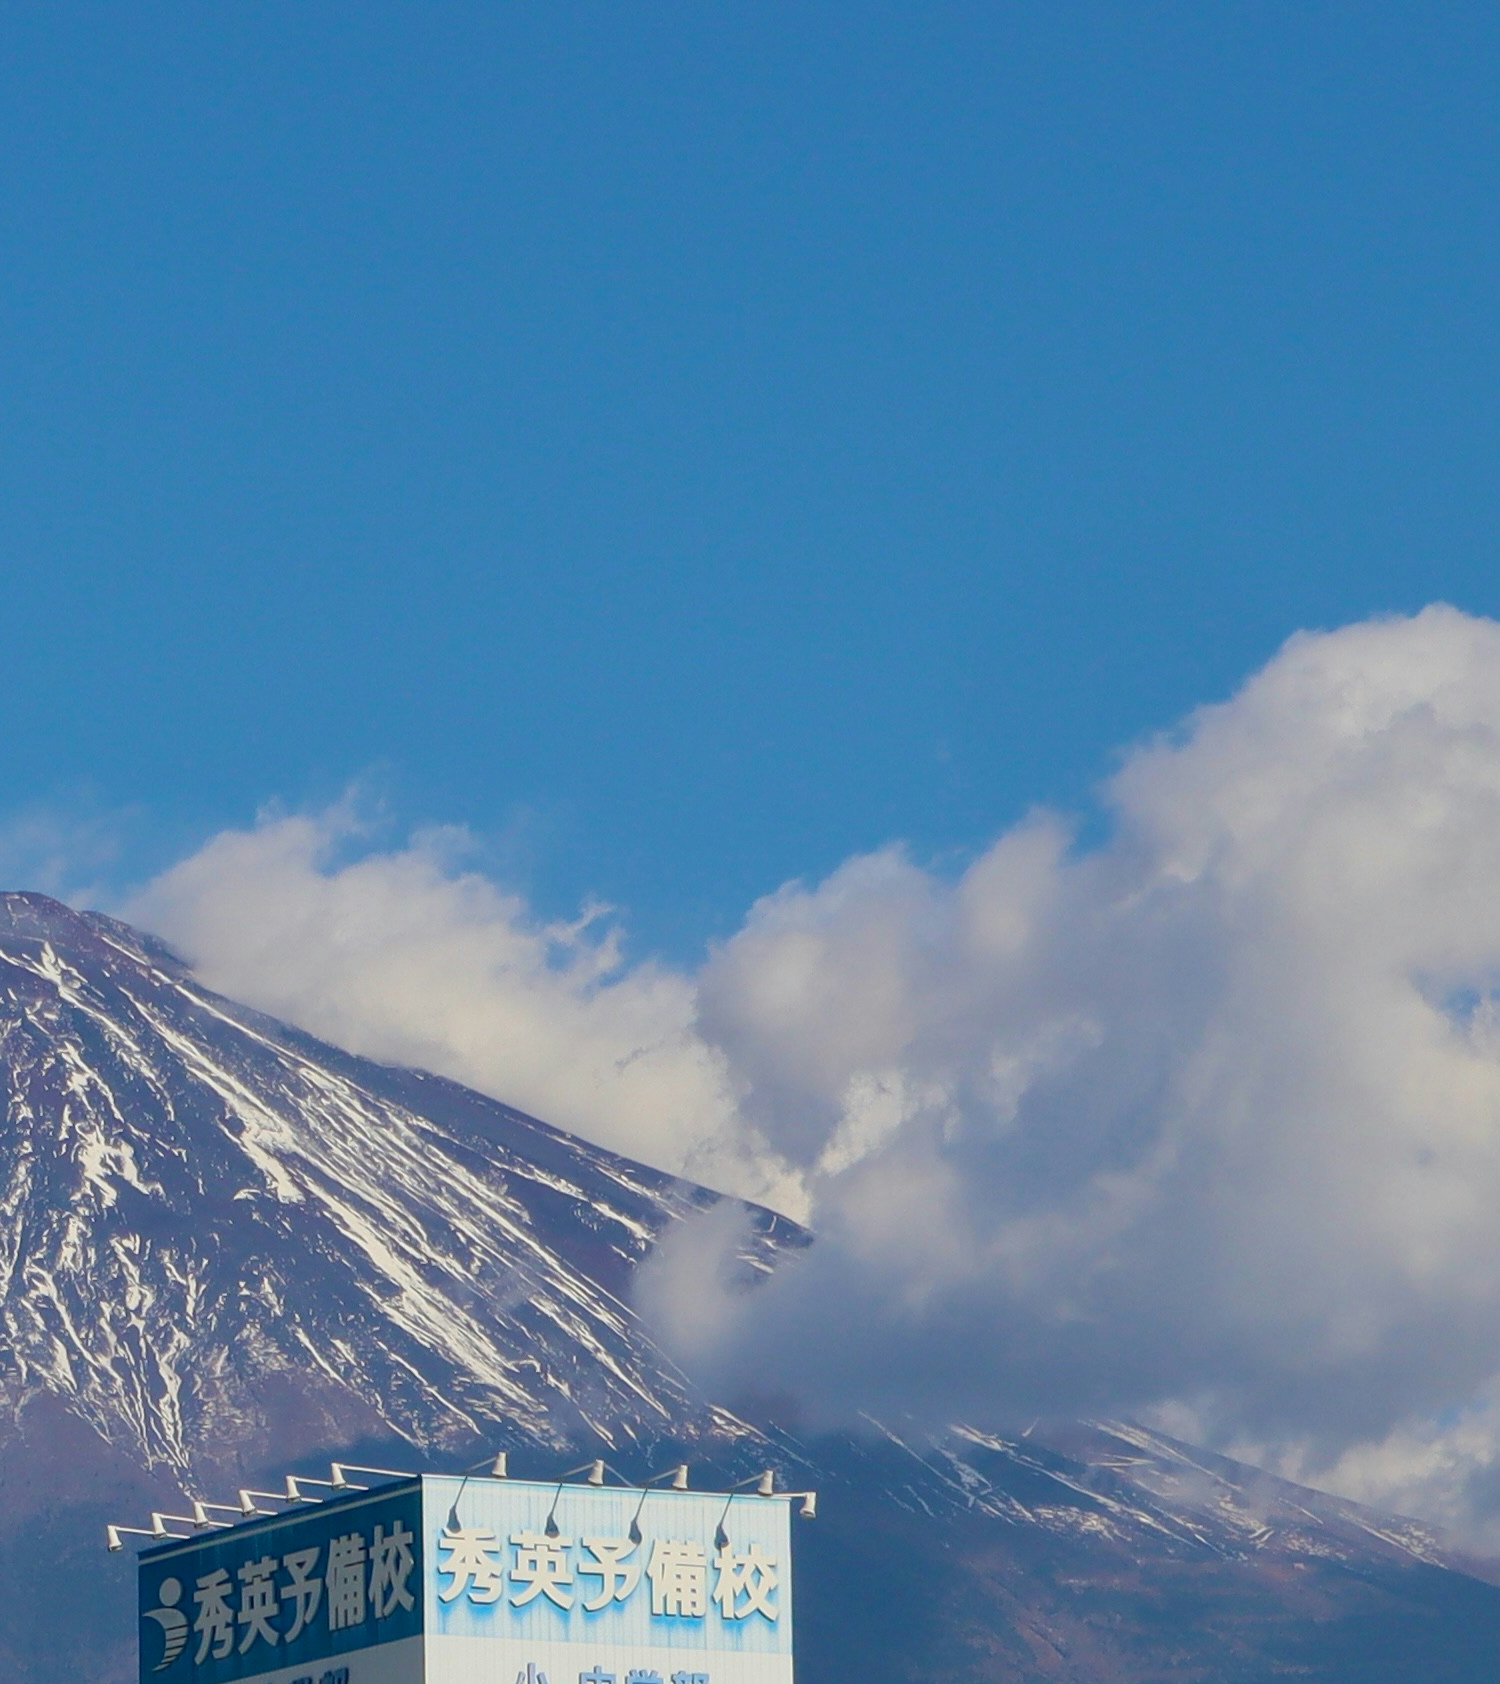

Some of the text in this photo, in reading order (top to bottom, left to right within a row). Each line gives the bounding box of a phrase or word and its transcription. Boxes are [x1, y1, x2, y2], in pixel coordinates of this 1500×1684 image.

[194, 1520, 415, 1665] 秀英予備校
[437, 1526, 780, 1622] 秀英予備校
